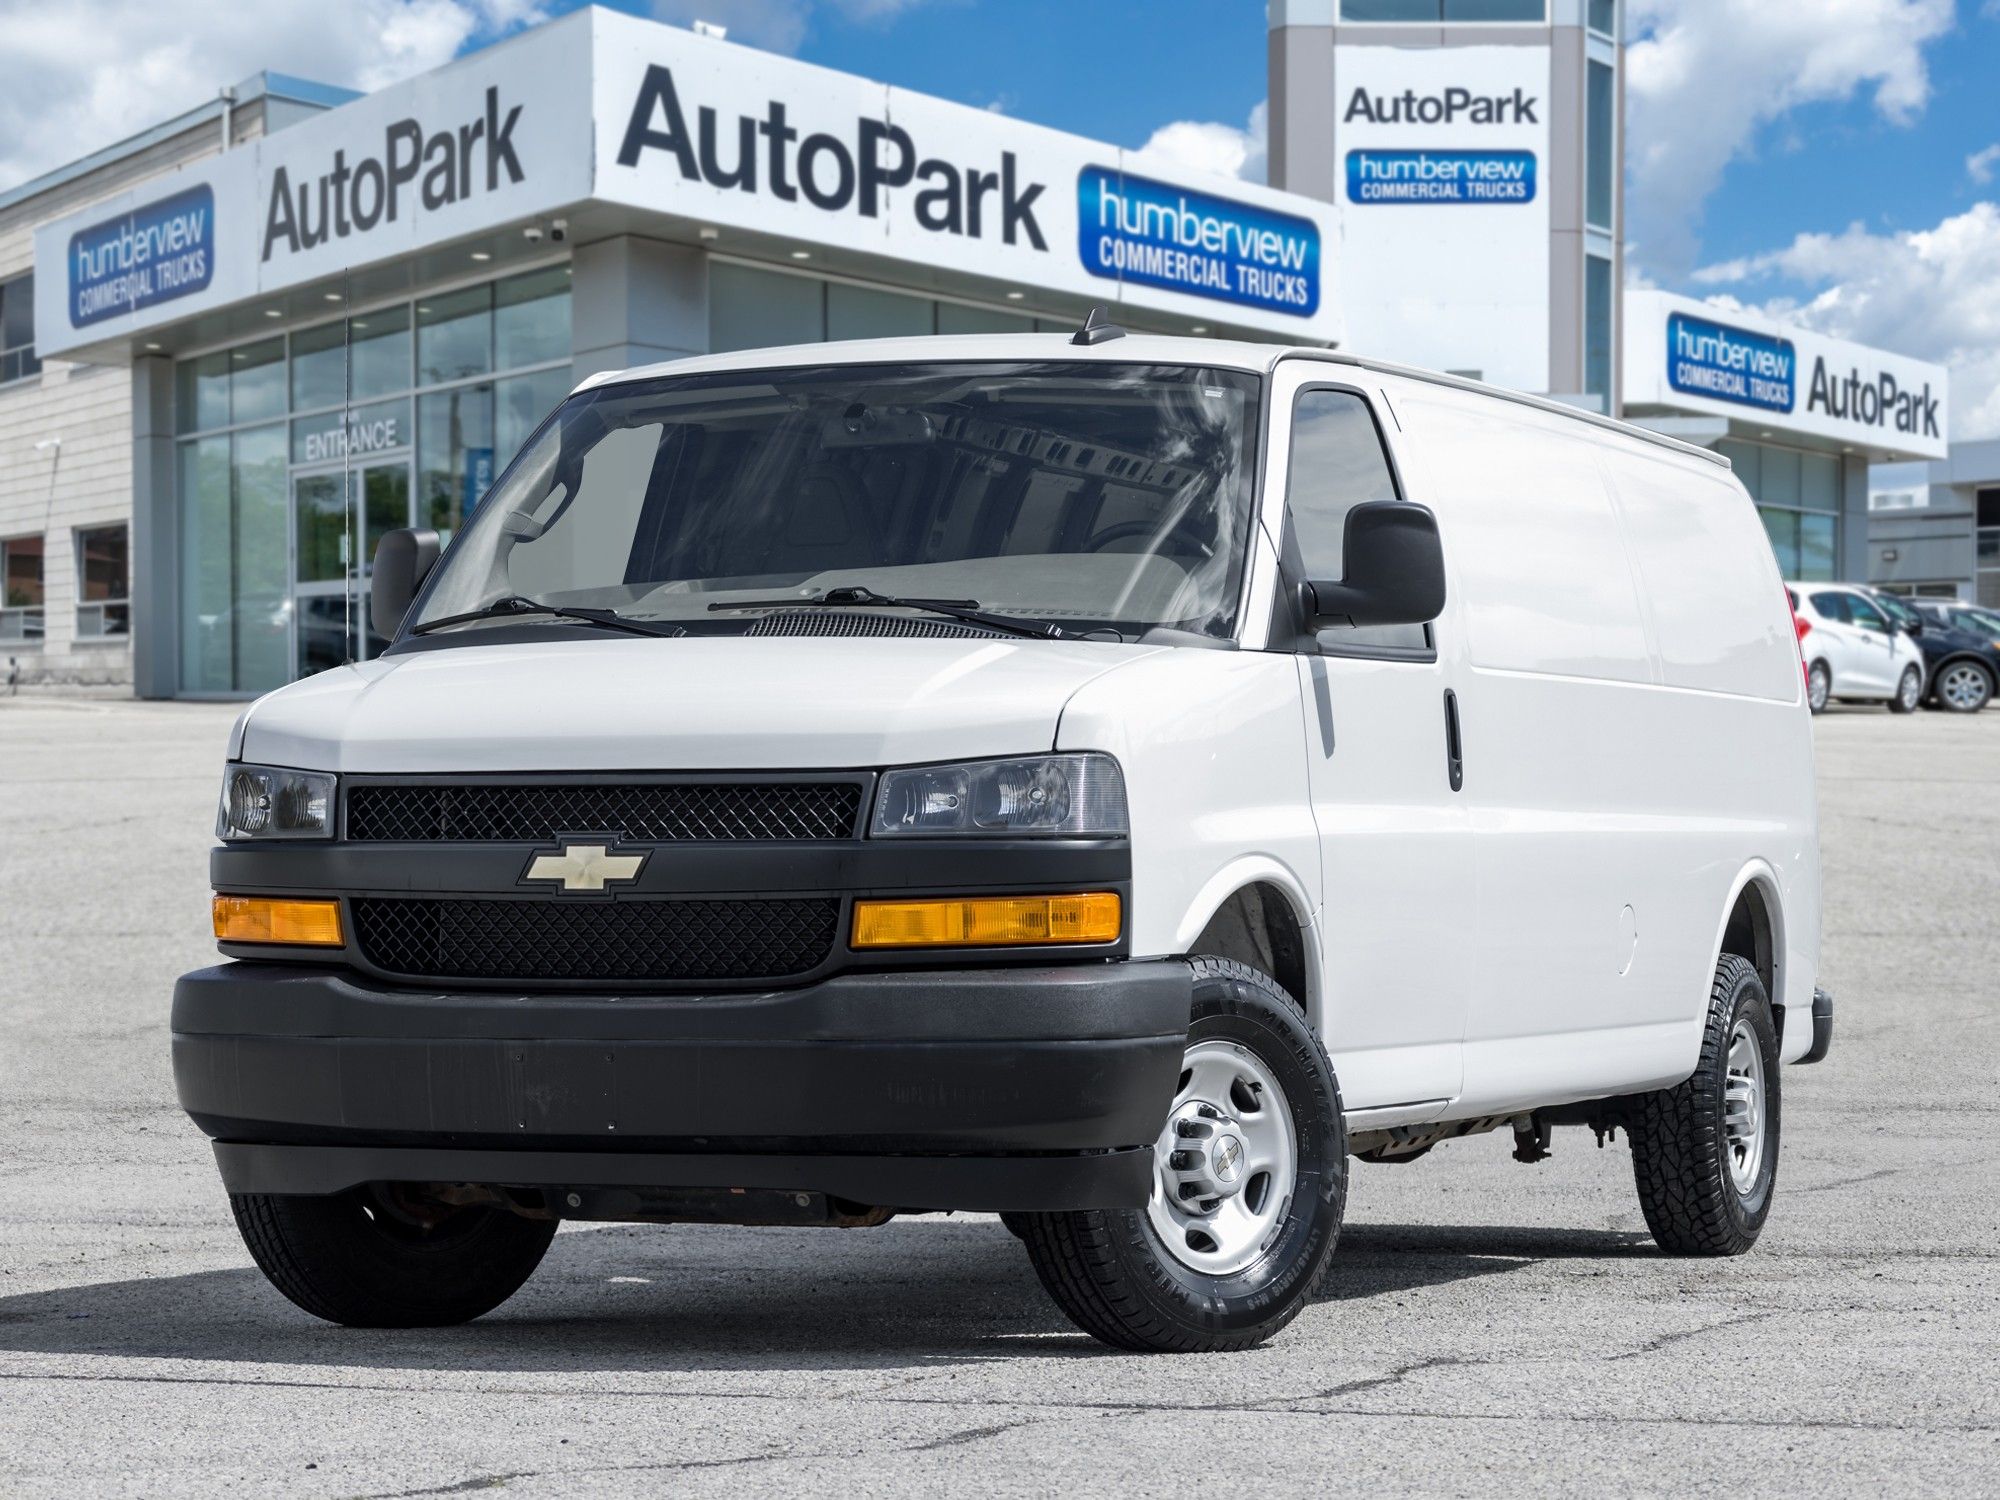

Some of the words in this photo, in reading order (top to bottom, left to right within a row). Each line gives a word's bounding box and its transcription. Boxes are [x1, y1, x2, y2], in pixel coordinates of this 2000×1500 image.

[1343, 87, 1539, 124] AutoPark
[262, 85, 525, 262] AutoPark
[616, 63, 1050, 253] AutoPark
[1360, 153, 1525, 180] humberview
[1361, 182, 1461, 199] COMMERCIAL
[1466, 181, 1526, 198] TRUCKS
[78, 208, 205, 284] humberview
[1100, 178, 1307, 271] humberview
[79, 269, 154, 317] COMMERCIAL
[156, 248, 206, 292] TRUCKS
[1100, 235, 1232, 291] COMMERCIAL
[1236, 263, 1309, 305] TRUCKS
[1678, 320, 1790, 380] humberview
[1678, 361, 1748, 397] COMMERCIAL
[1750, 377, 1790, 405] TRUCKS
[1807, 355, 1940, 439] AutoPark
[306, 418, 397, 461] ENTRANCE
